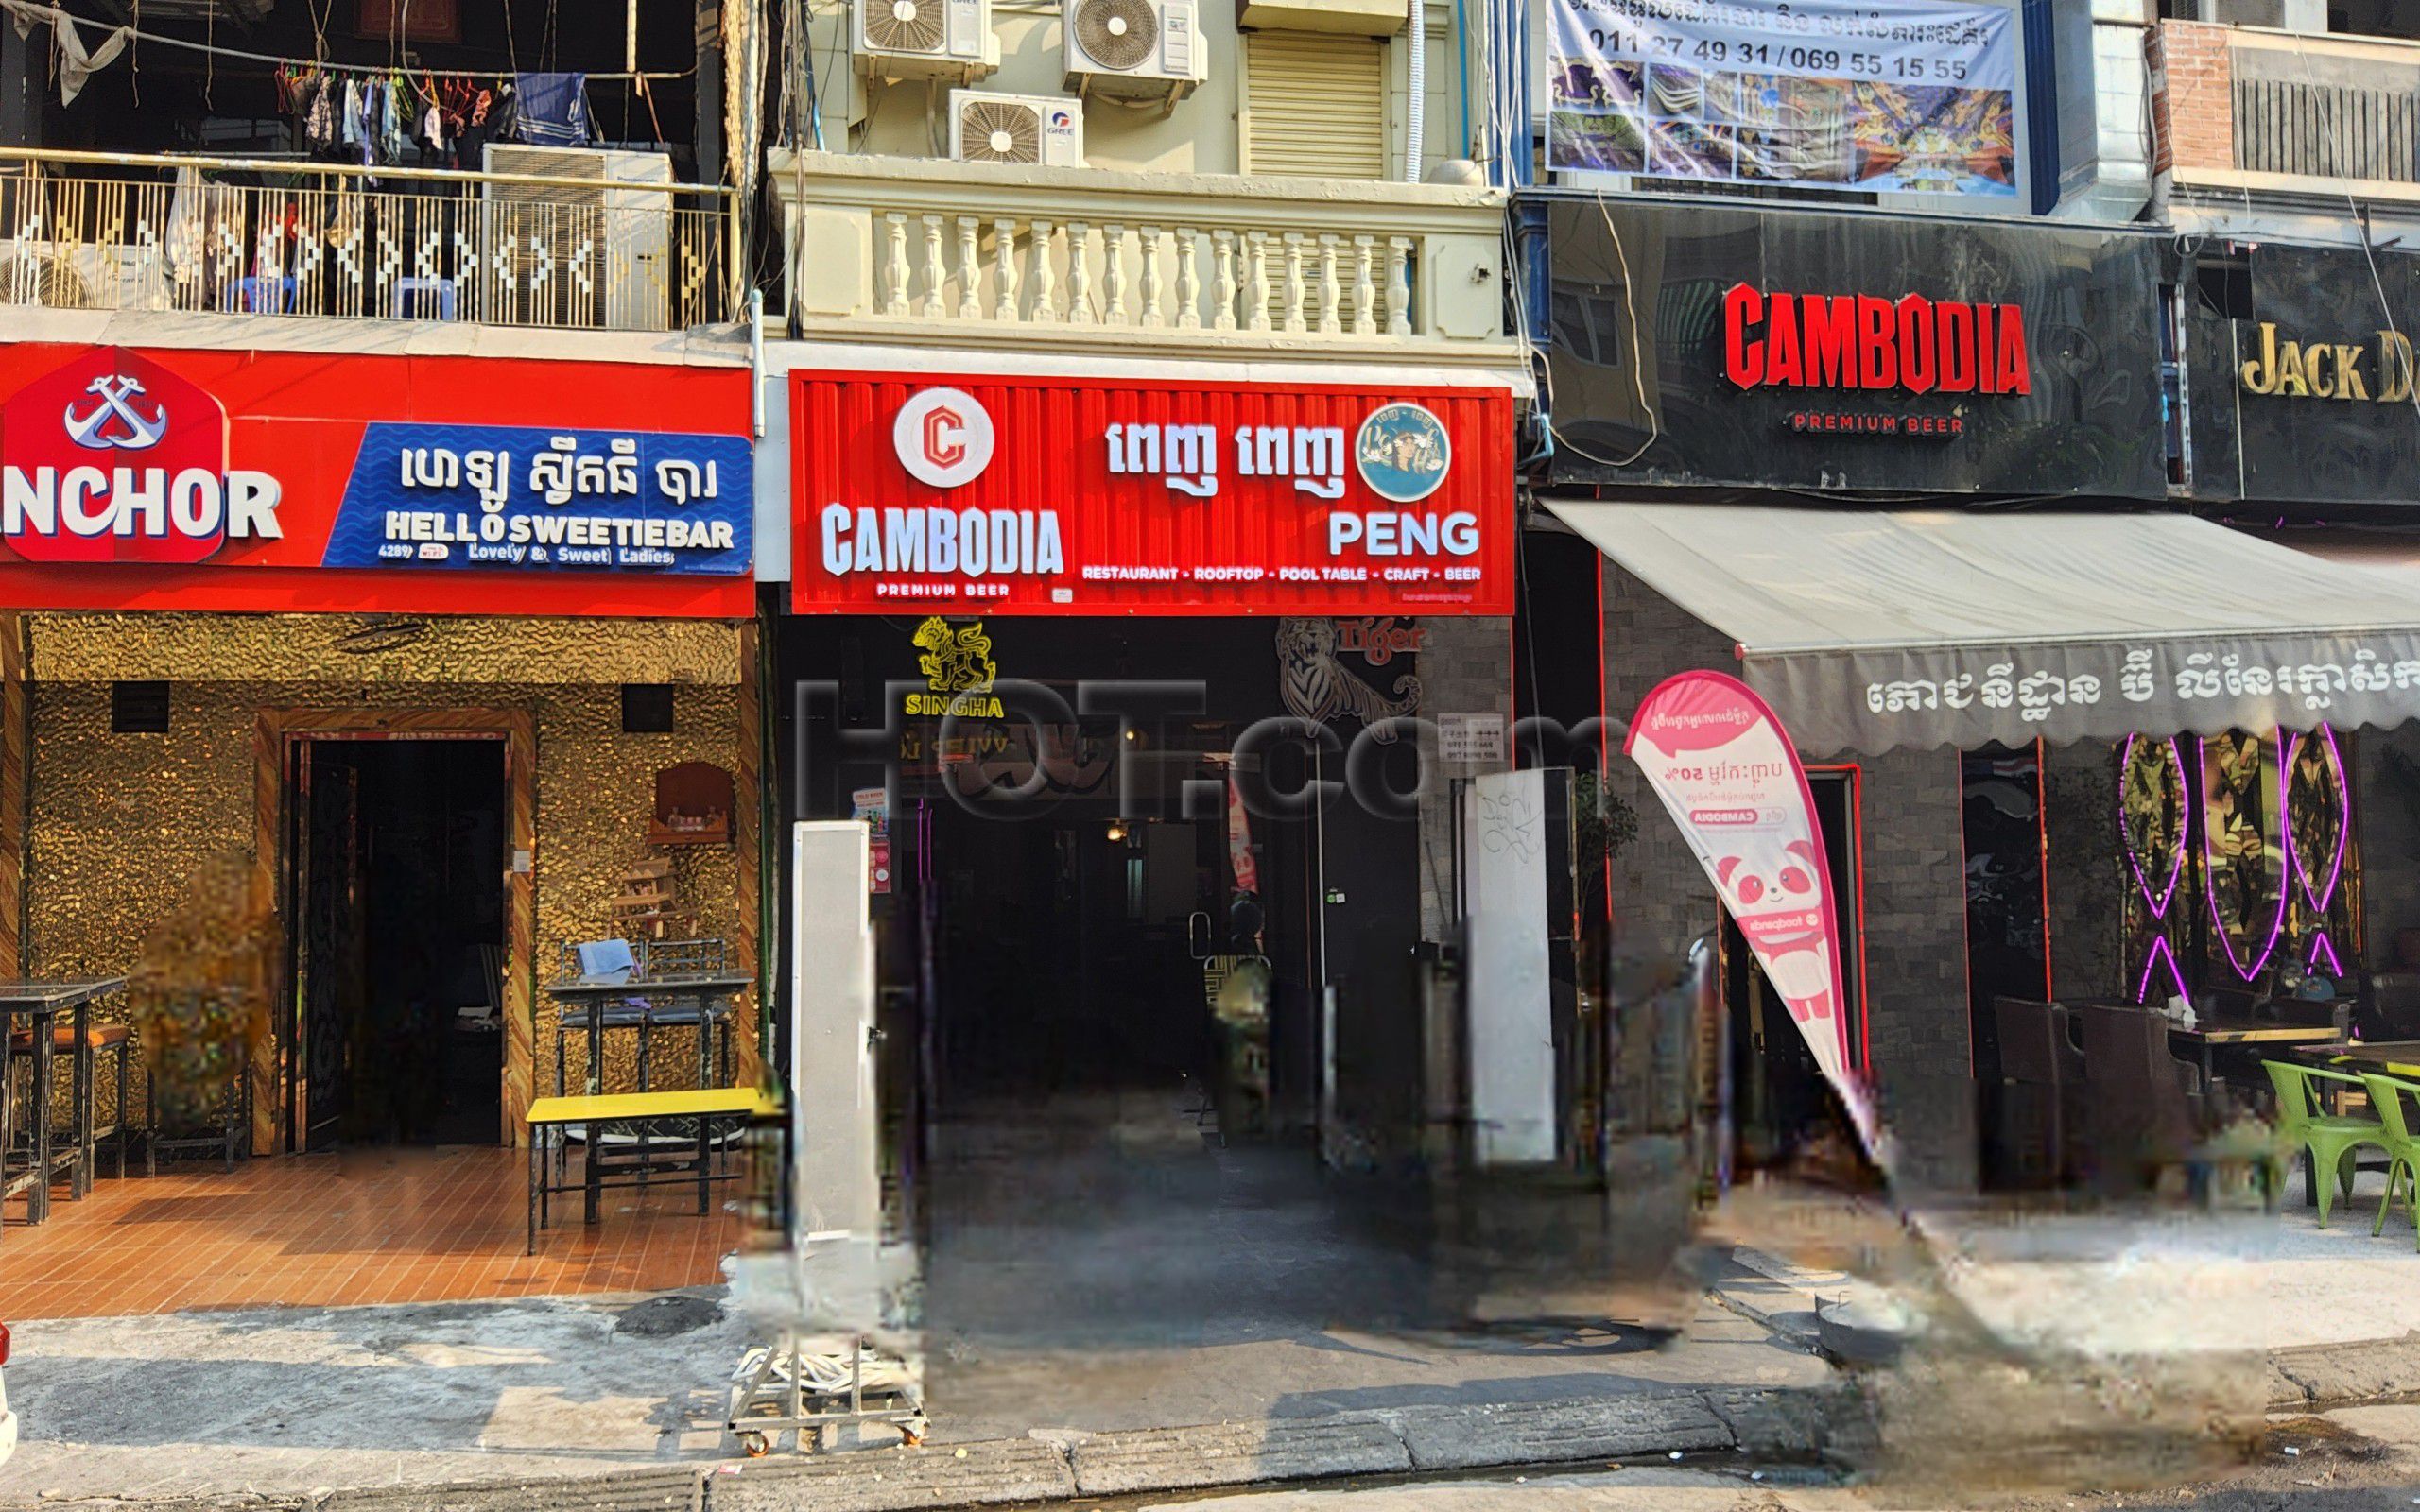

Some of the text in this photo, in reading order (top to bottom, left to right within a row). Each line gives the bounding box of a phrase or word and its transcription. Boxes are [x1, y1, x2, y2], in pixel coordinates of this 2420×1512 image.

[1589, 28, 1638, 53] 011
[1651, 36, 1683, 57] 27
[1693, 40, 1727, 62] 49
[1850, 53, 1883, 75] 55
[1893, 56, 1924, 77] 15
[1934, 60, 1967, 80] 55
[1725, 283, 2031, 395] CAMBODIA
[2240, 322, 2420, 403] JACK D
[1794, 413, 1964, 434] PREMIUM BEER
[0, 465, 284, 538] NCHOR
[468, 542, 675, 566] Lovely & Sweet Ladies
[821, 502, 1064, 576] CAMBODIA
[1329, 511, 1480, 557] PENG
[876, 583, 1011, 597] PREMIUM BEER
[1082, 567, 1482, 581] RESTAURANT ROOFTOP POOL TABLE CRAFT BEER
[1338, 617, 1426, 663] Tiger
[906, 694, 1005, 718] SINGHA
